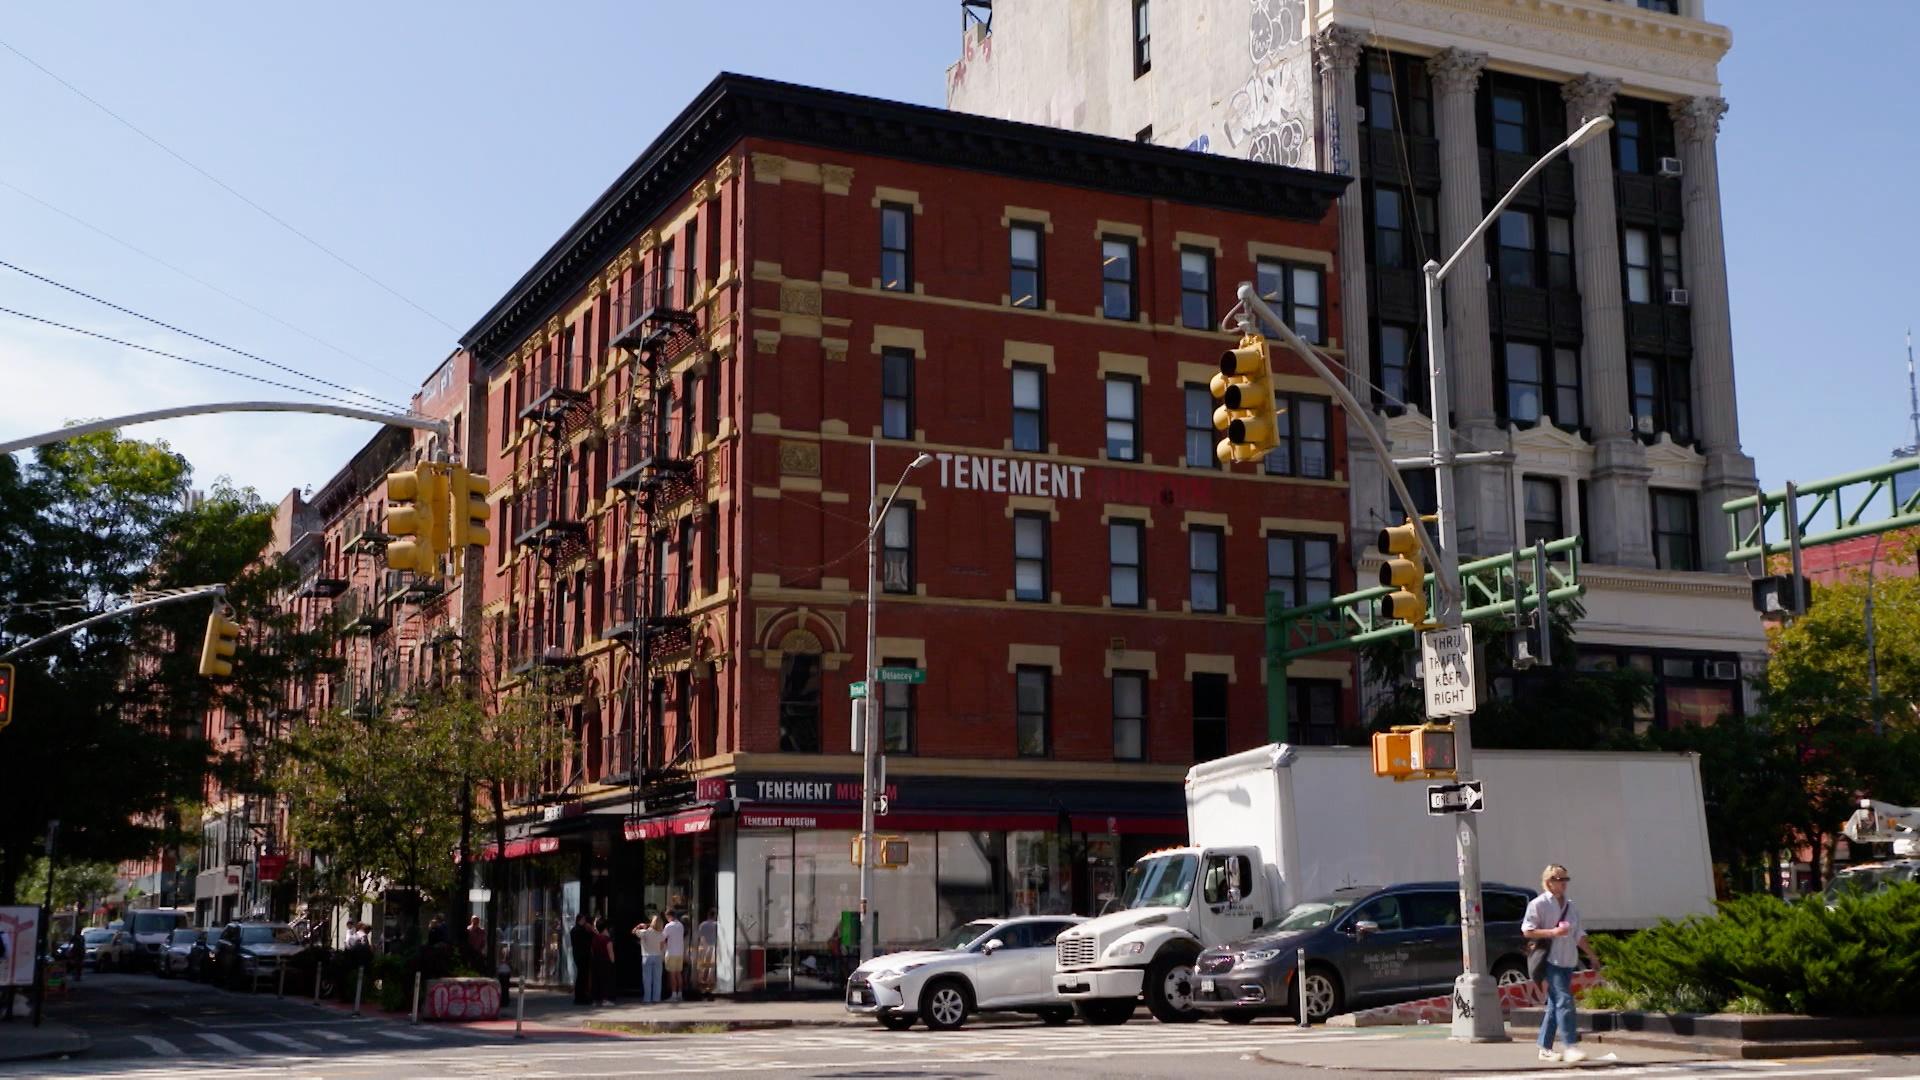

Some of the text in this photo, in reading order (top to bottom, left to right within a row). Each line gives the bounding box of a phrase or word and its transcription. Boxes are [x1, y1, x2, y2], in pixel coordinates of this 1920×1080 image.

[936, 452, 1085, 500] TENEMENT
[1433, 635, 1461, 650] THRU
[1429, 652, 1466, 669] TRAFFIC
[1434, 689, 1465, 706] RIGHT
[757, 782, 897, 801] TENEMENT MUSM
[1435, 791, 1450, 806] ONE
[743, 815, 816, 828] TENEMENT MUSEUM
